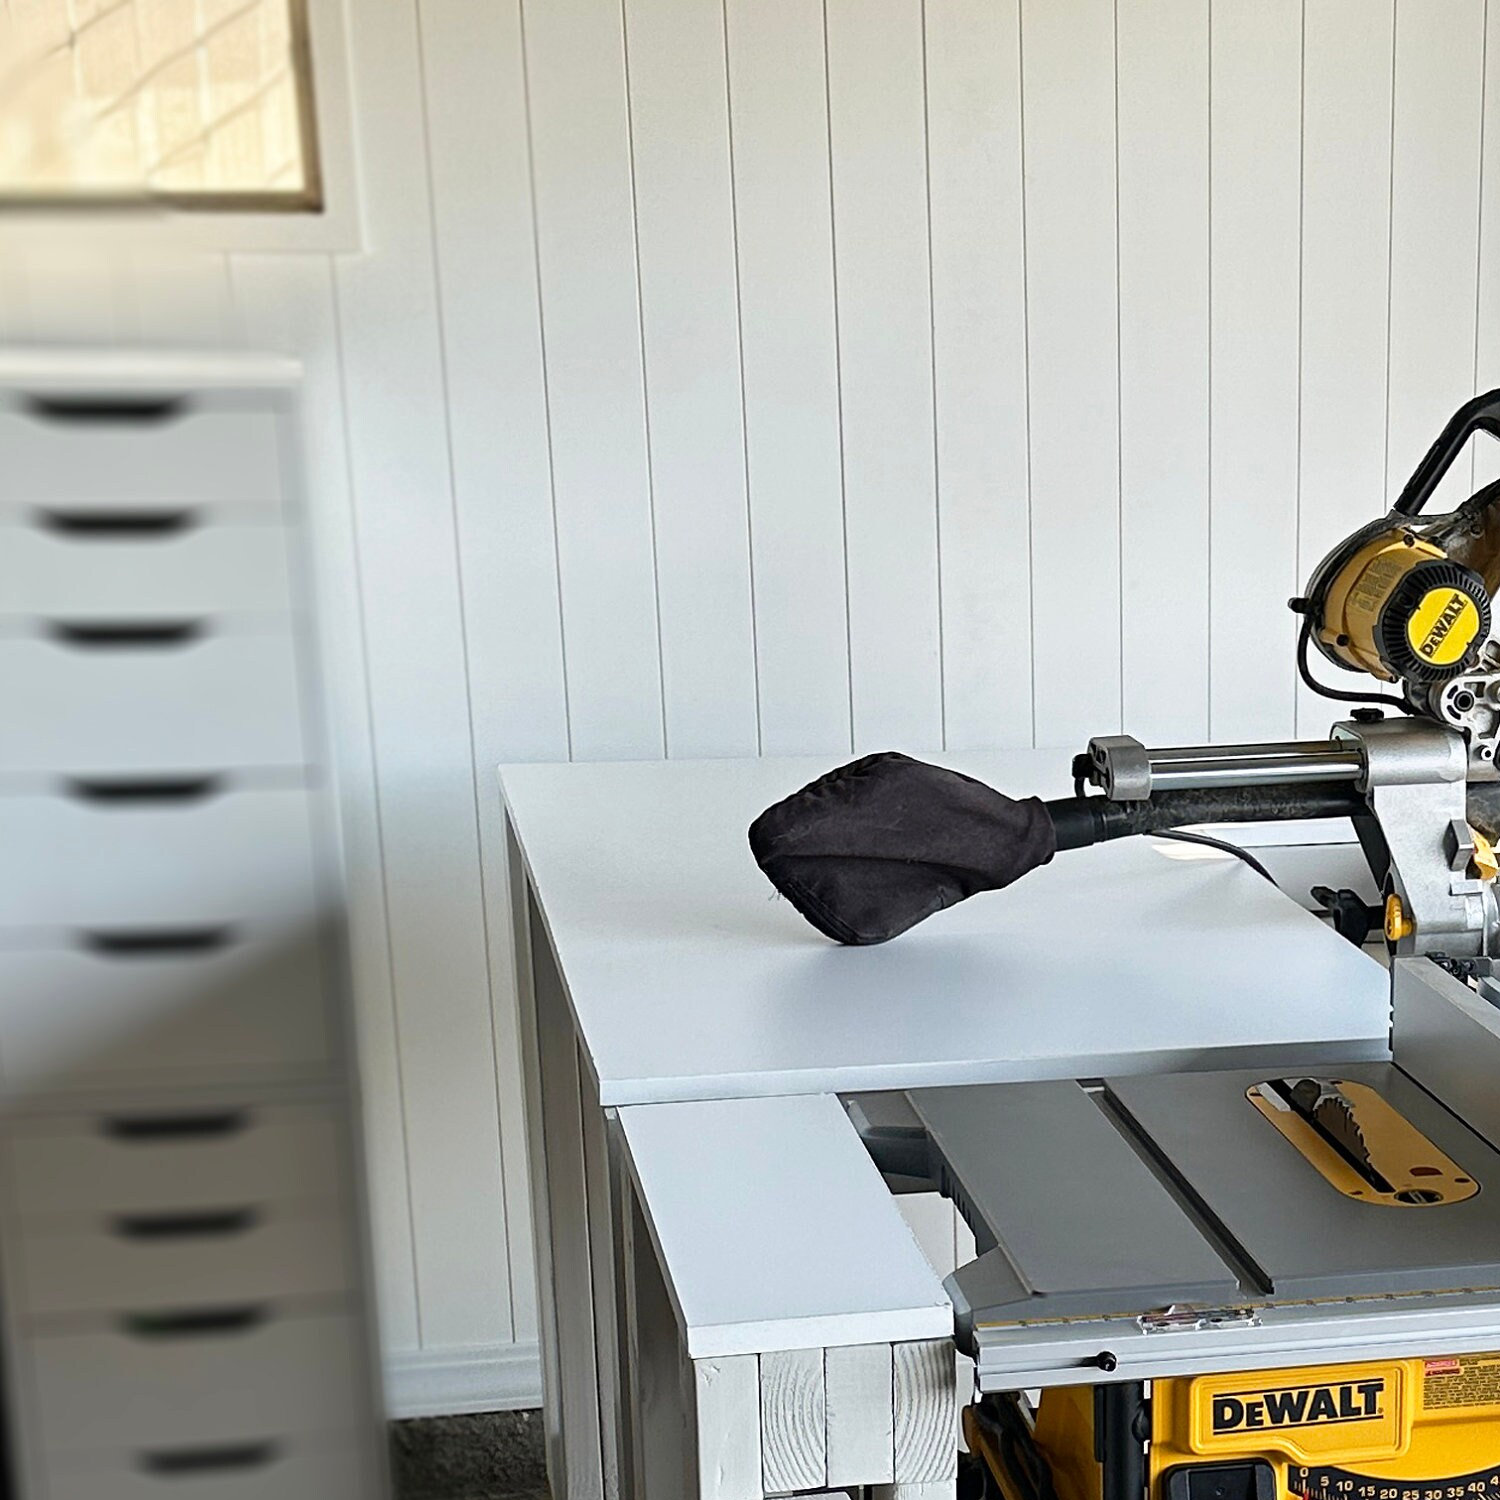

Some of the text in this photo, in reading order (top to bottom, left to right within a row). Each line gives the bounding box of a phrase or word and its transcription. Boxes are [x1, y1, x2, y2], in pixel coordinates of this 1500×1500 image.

[1420, 593, 1466, 658] DEWALT
[1213, 1382, 1384, 1431] DEWALT
[1300, 1467, 1309, 1477] 0
[1320, 1476, 1330, 1487] 5
[1336, 1481, 1353, 1492] 10
[1358, 1486, 1376, 1497] 15
[1380, 1488, 1398, 1499] 20
[1402, 1490, 1420, 1500] 25
[1424, 1490, 1442, 1500] 30
[1447, 1486, 1465, 1497] 35
[1467, 1482, 1486, 1493] 40
